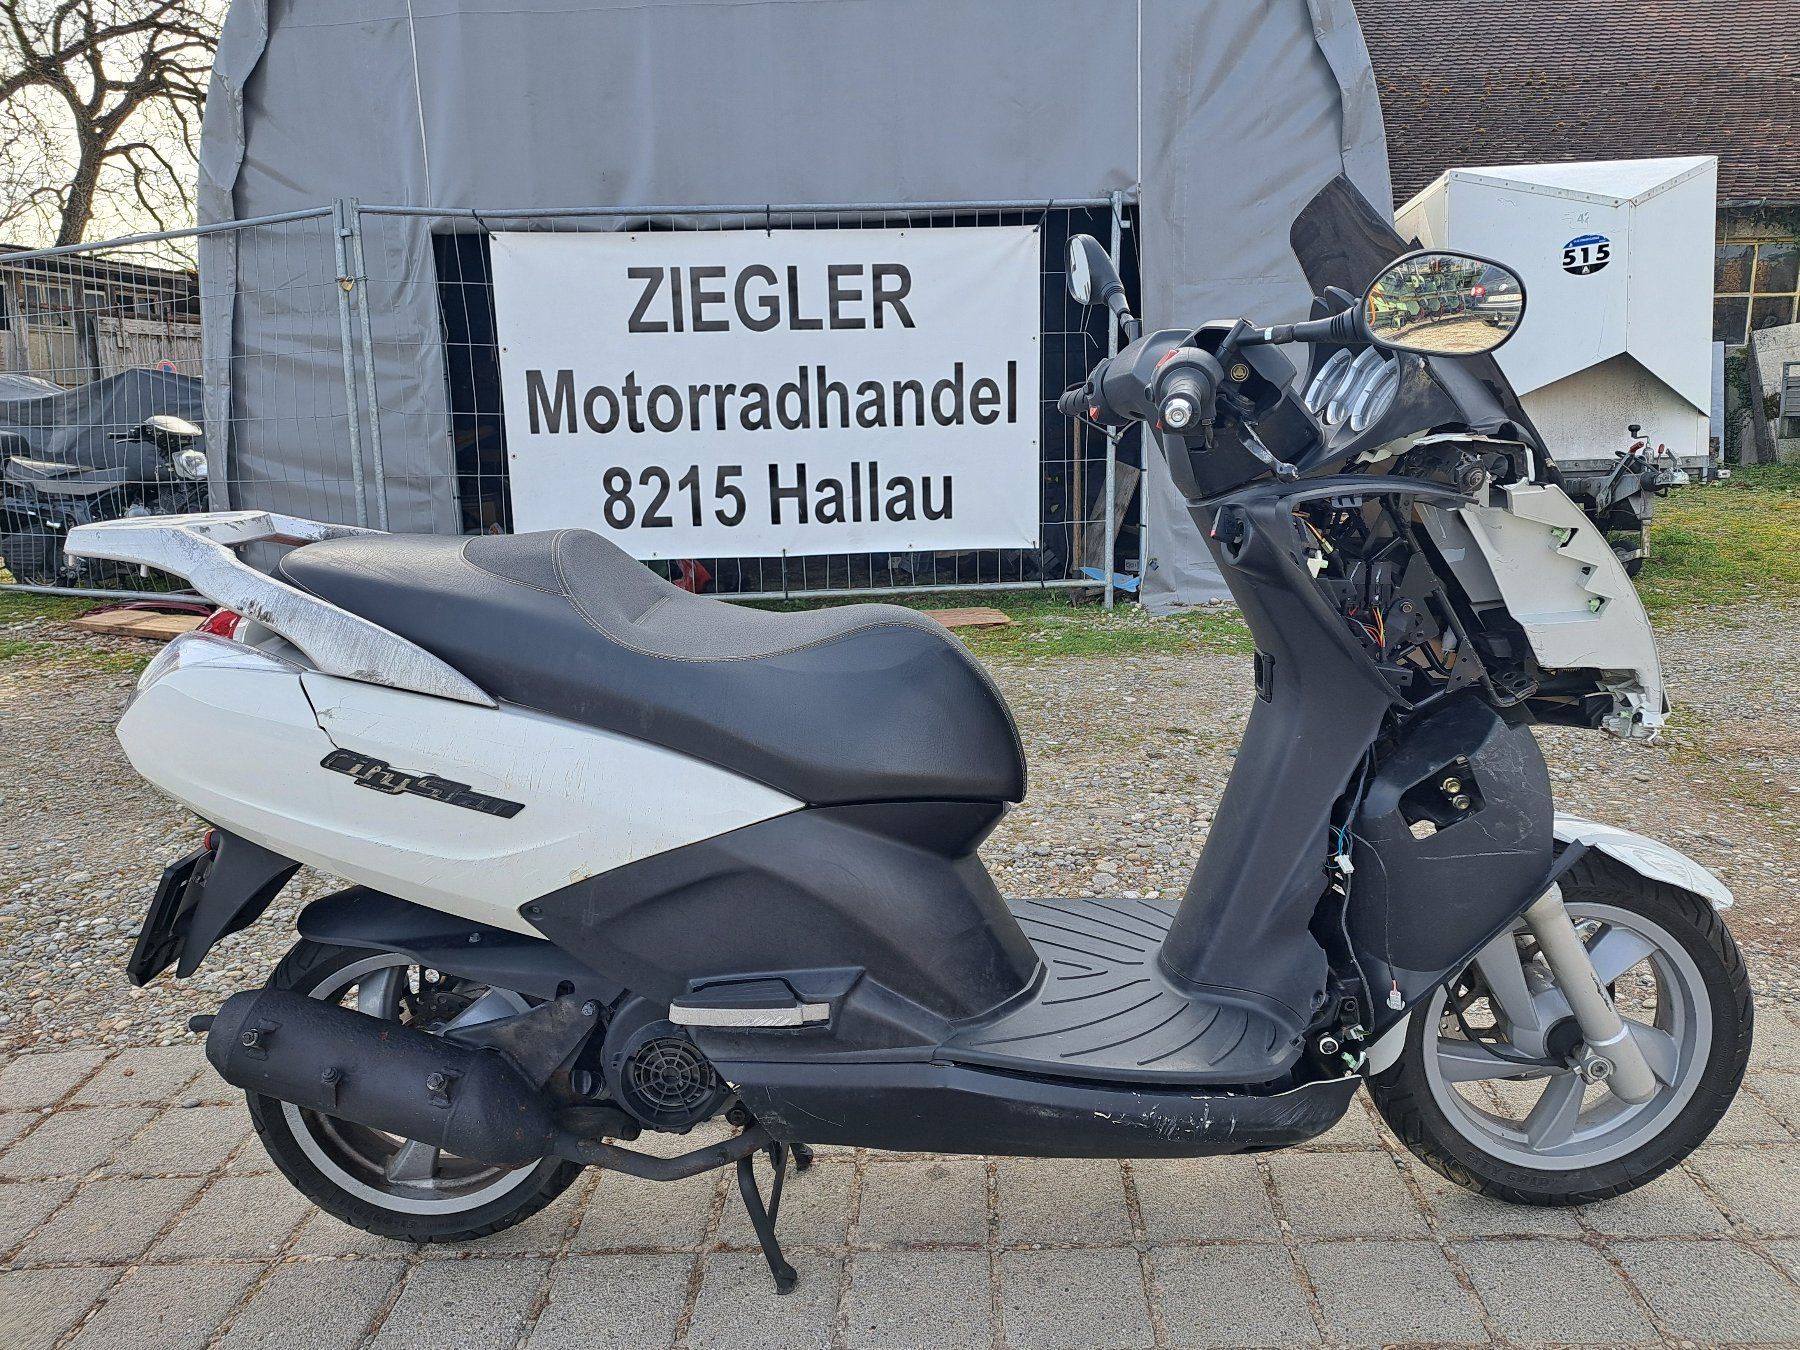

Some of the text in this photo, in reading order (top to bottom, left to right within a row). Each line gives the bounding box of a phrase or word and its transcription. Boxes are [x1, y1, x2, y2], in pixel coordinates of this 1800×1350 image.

[1562, 243, 1610, 266] 515
[627, 263, 916, 334] ZIEGLER
[525, 360, 1018, 435] Motorradhandel
[602, 461, 953, 530] 8215 Hallau
